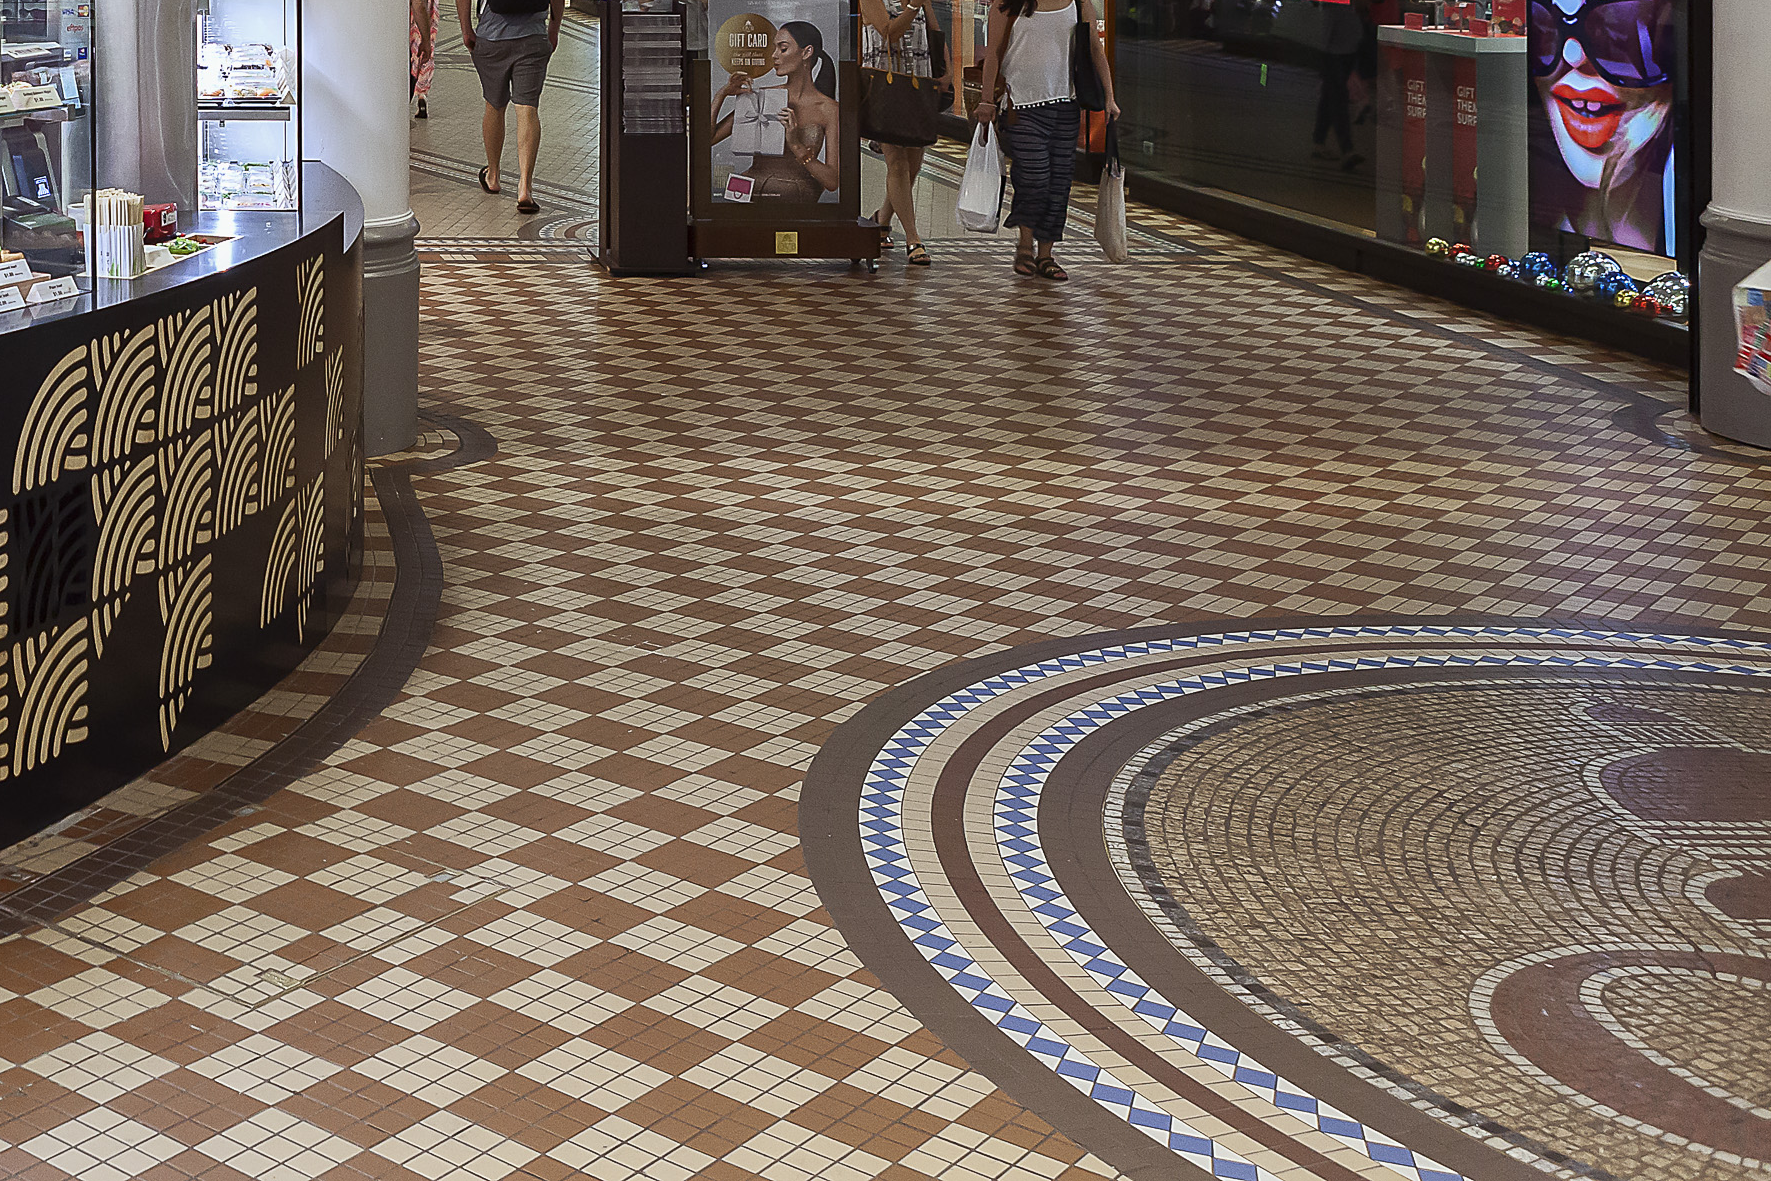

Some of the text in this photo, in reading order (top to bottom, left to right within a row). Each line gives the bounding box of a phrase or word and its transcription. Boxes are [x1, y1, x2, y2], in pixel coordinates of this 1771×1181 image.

[729, 33, 768, 48] GIFT CARD
[1407, 80, 1425, 92] GIFT
[1457, 86, 1475, 98] GIFT
